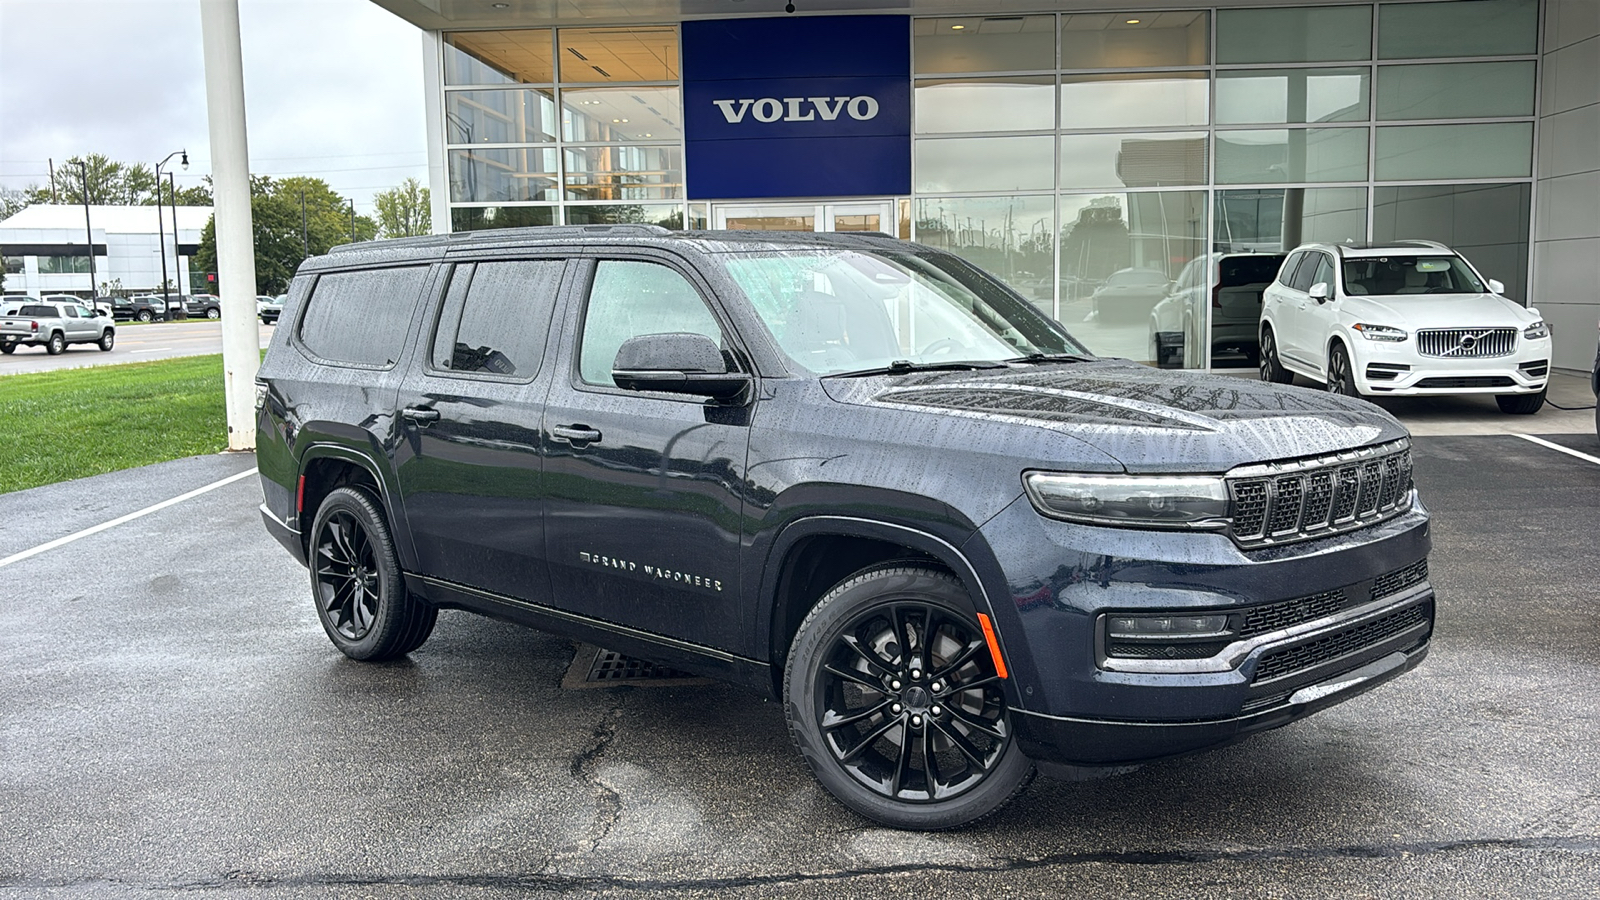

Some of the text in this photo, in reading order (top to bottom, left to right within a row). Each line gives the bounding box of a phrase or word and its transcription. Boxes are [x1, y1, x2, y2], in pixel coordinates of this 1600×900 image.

[713, 96, 879, 123] VOLVO
[593, 554, 722, 591] GRAND WAGONEER
